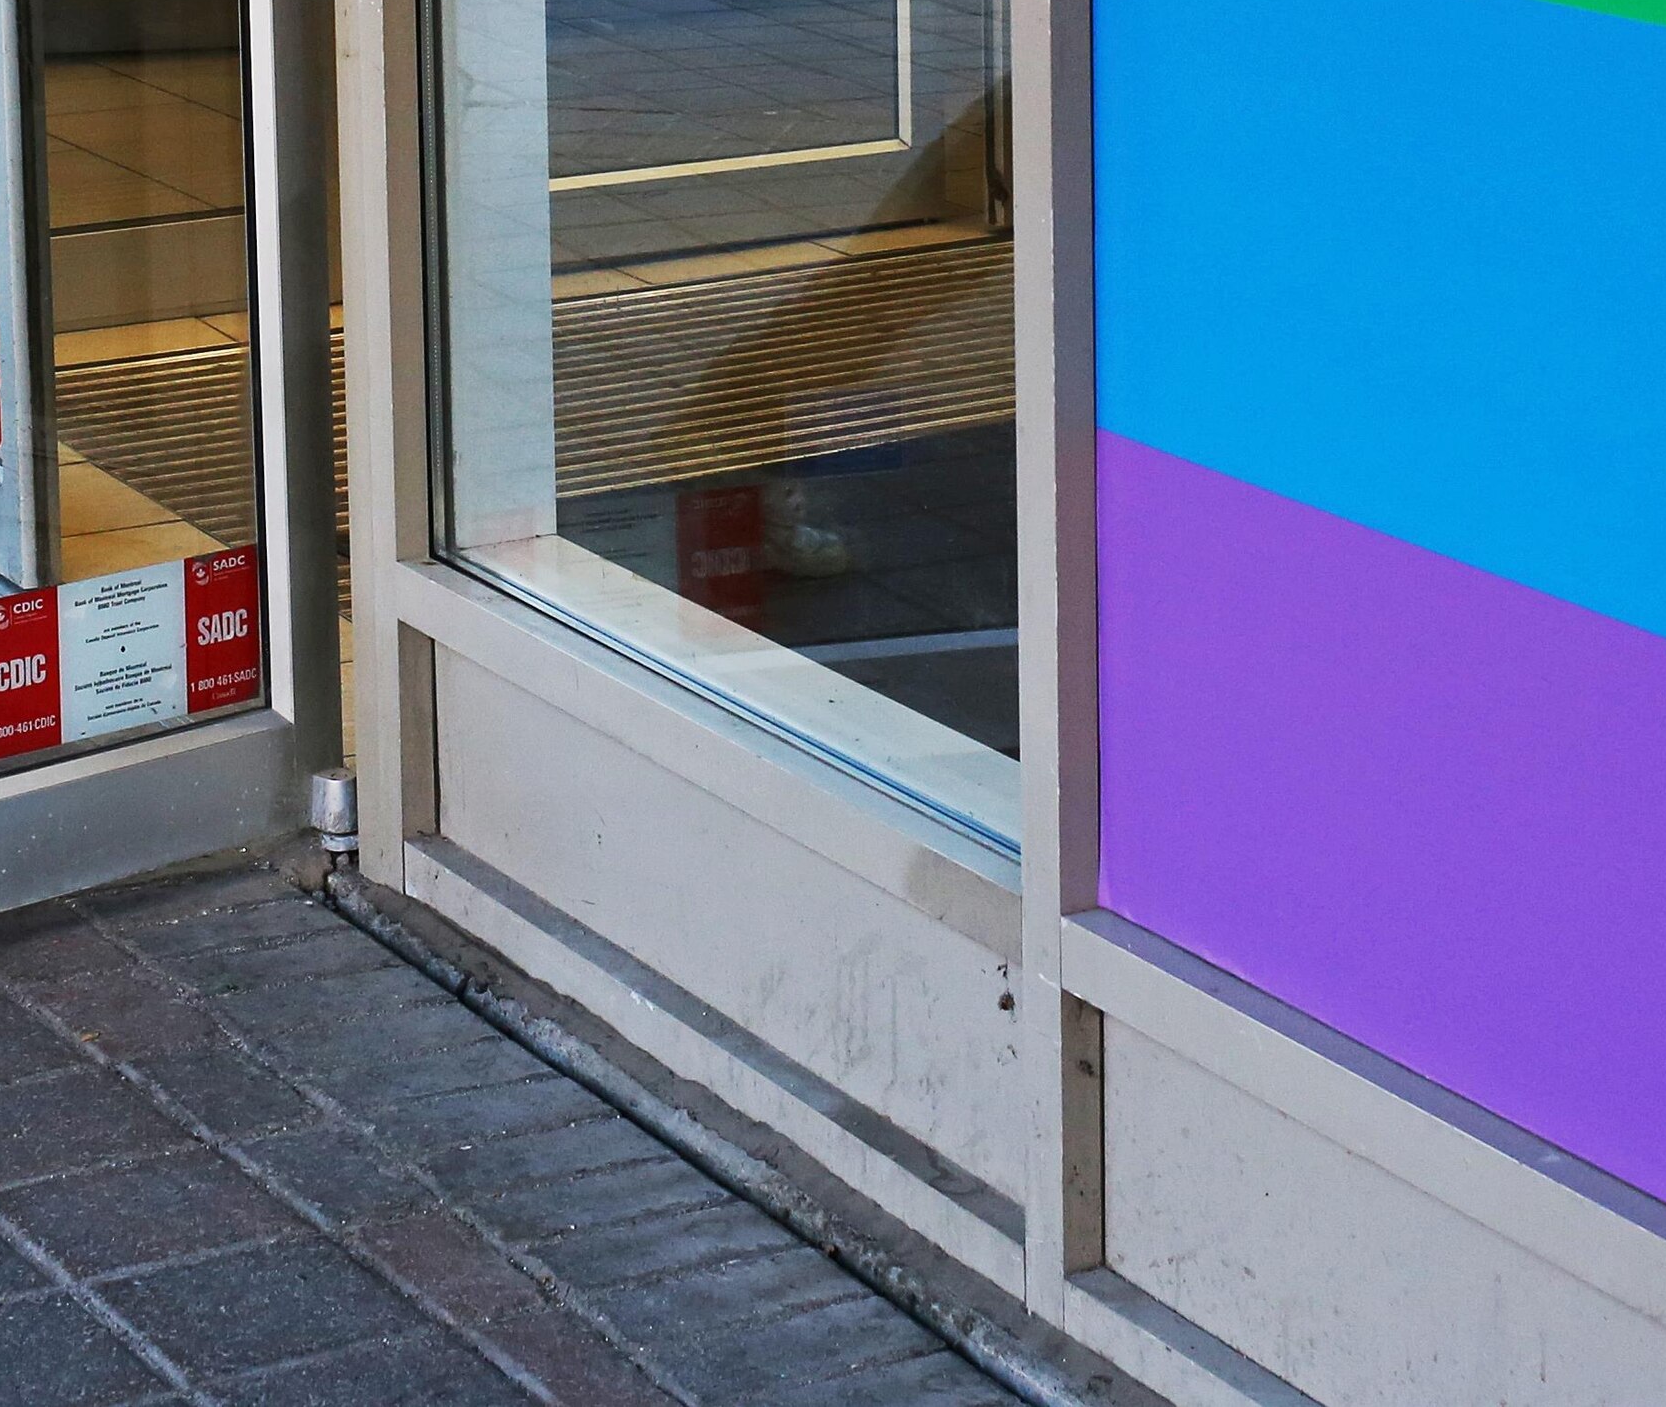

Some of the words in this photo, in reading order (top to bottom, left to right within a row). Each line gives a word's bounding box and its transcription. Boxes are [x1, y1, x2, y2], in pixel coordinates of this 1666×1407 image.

[213, 555, 245, 572] SADC
[13, 598, 44, 614] CDIC
[197, 608, 248, 646] SADC
